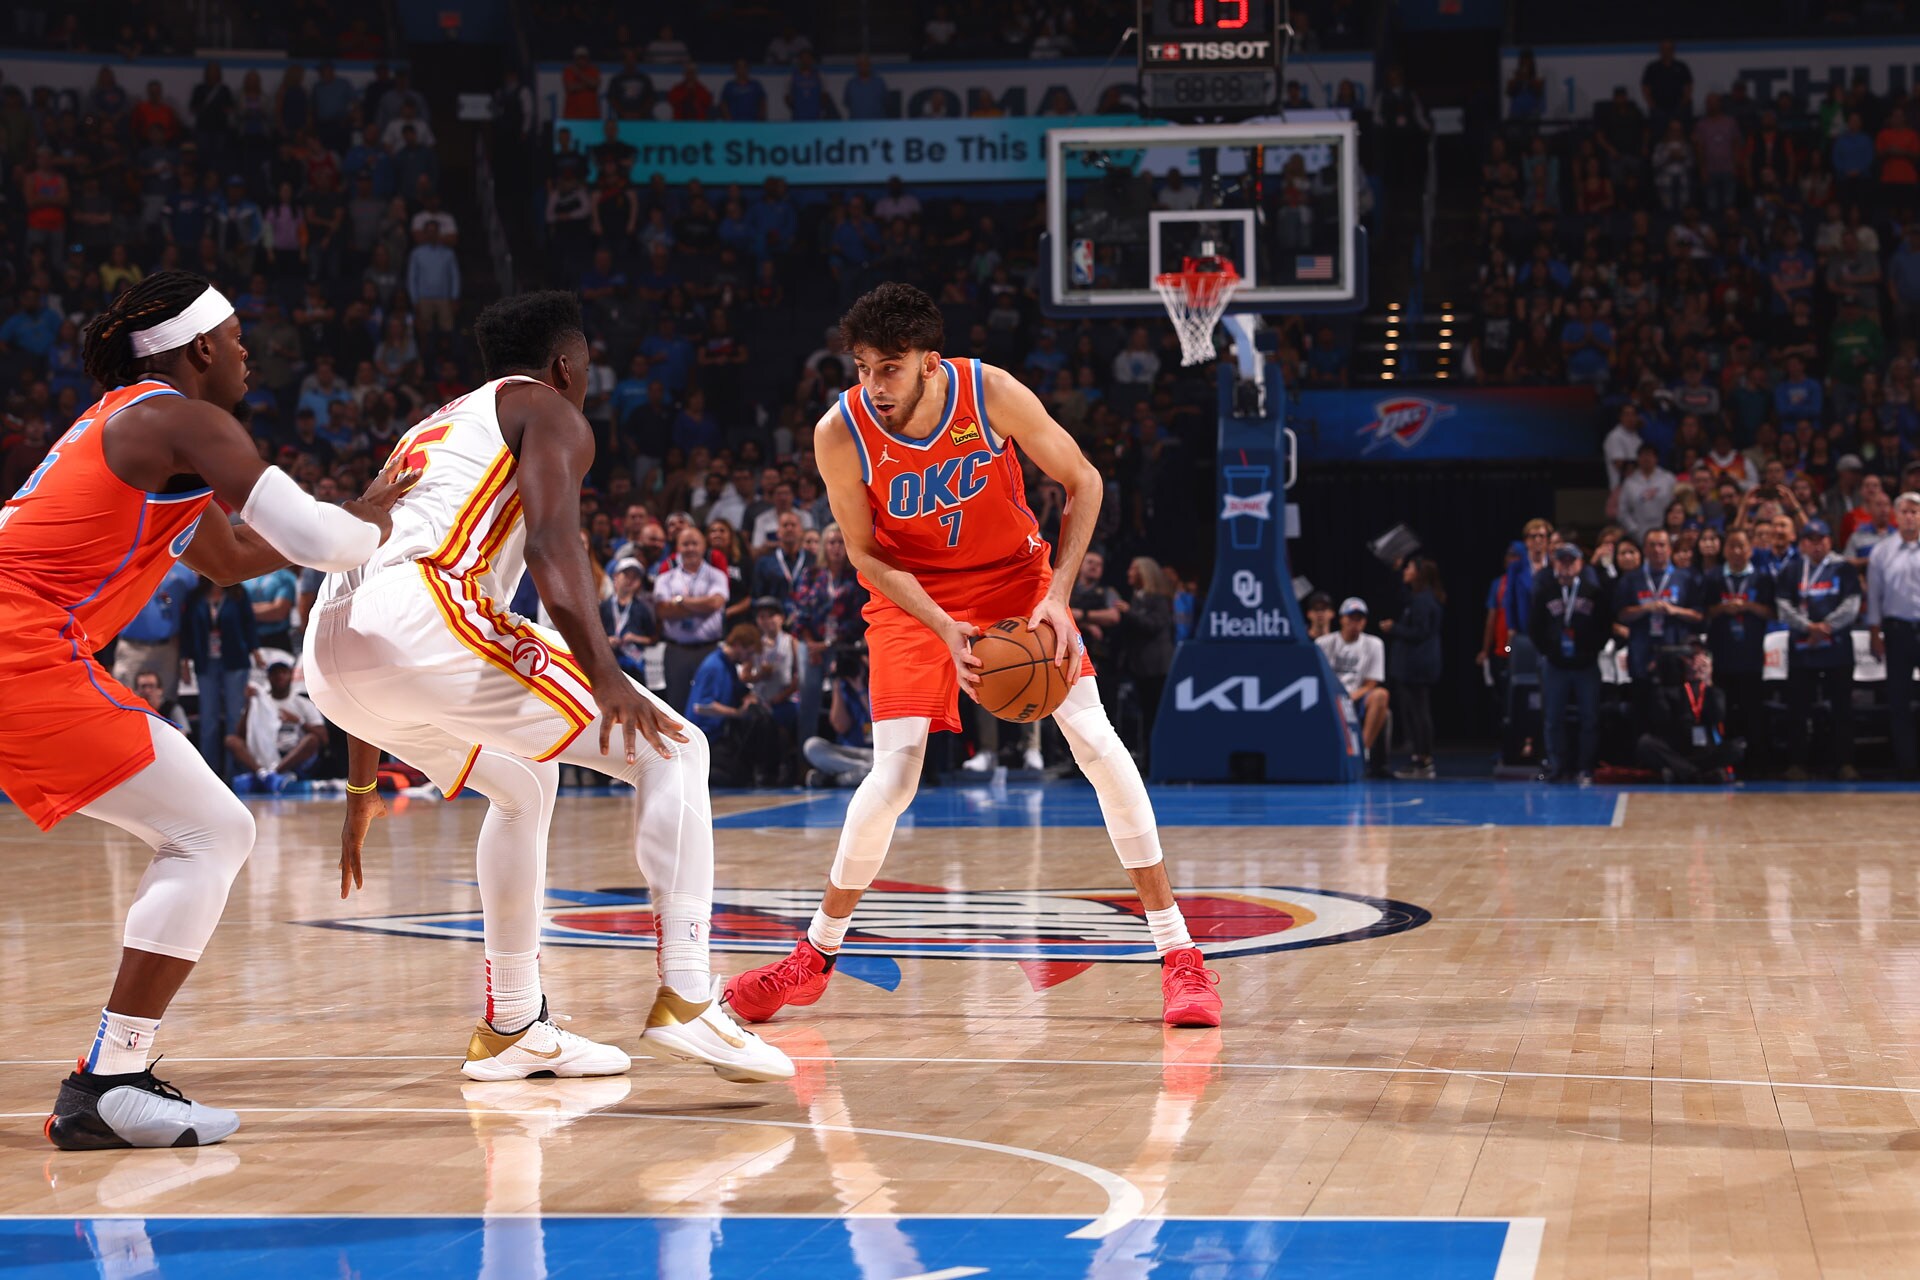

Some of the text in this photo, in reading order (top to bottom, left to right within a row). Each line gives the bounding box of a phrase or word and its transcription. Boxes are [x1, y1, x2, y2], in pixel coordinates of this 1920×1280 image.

[1180, 41, 1271, 60] TISSOT
[1739, 65, 1920, 117] THU
[725, 136, 894, 167] Shouldn't
[904, 137, 948, 163] Be
[956, 131, 1028, 162] This
[887, 450, 993, 519] OKC
[938, 510, 963, 547] 7
[1210, 608, 1290, 638] Health
[1175, 676, 1319, 711] KIA
